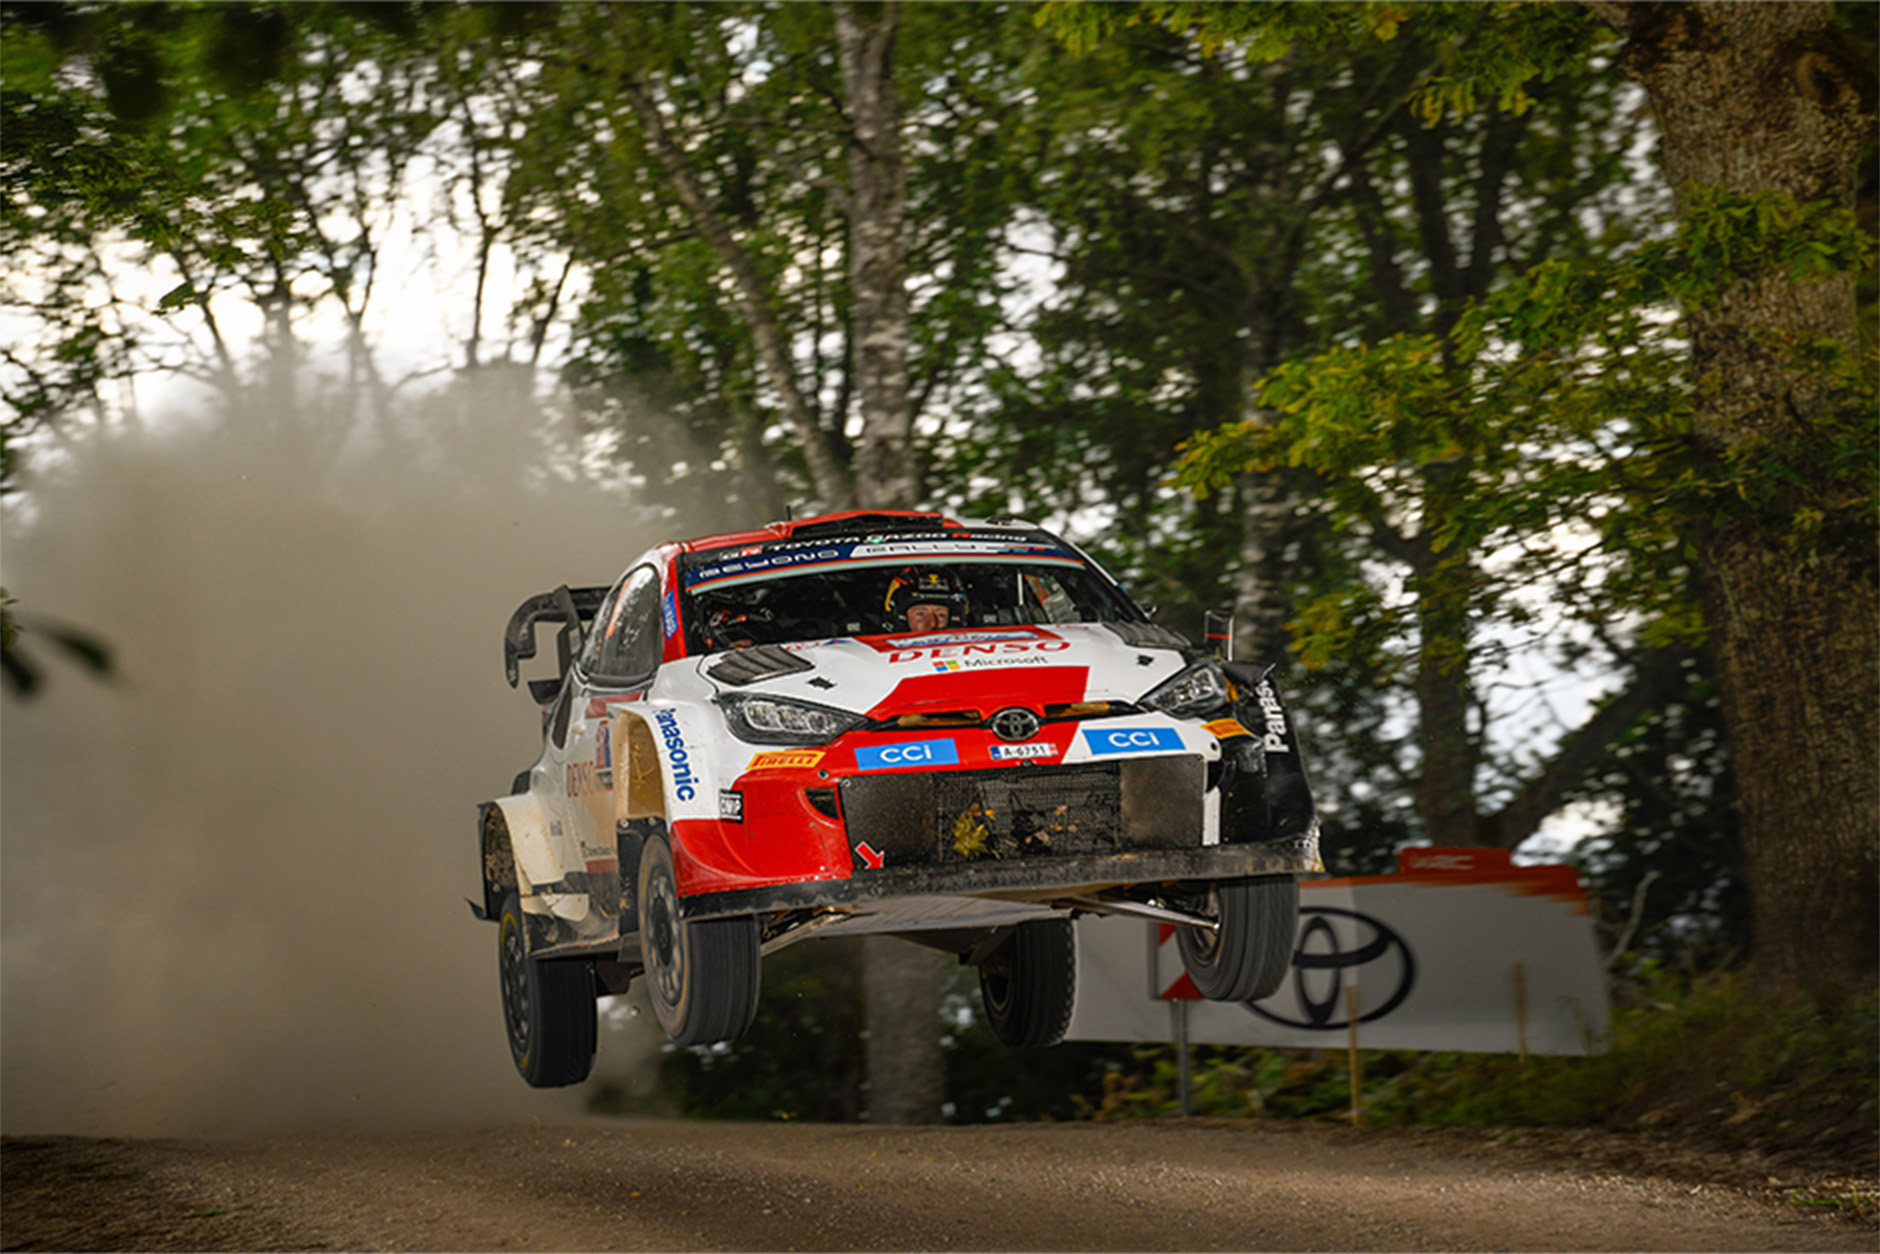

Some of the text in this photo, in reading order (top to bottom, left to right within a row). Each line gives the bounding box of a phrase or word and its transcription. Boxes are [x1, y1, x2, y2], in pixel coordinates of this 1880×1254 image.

[767, 536, 860, 552] TOYOTA
[699, 549, 839, 579] BEYOND
[888, 640, 1071, 664] DENSO
[963, 655, 1048, 668] Microsoft
[751, 752, 818, 768] PIRELLI
